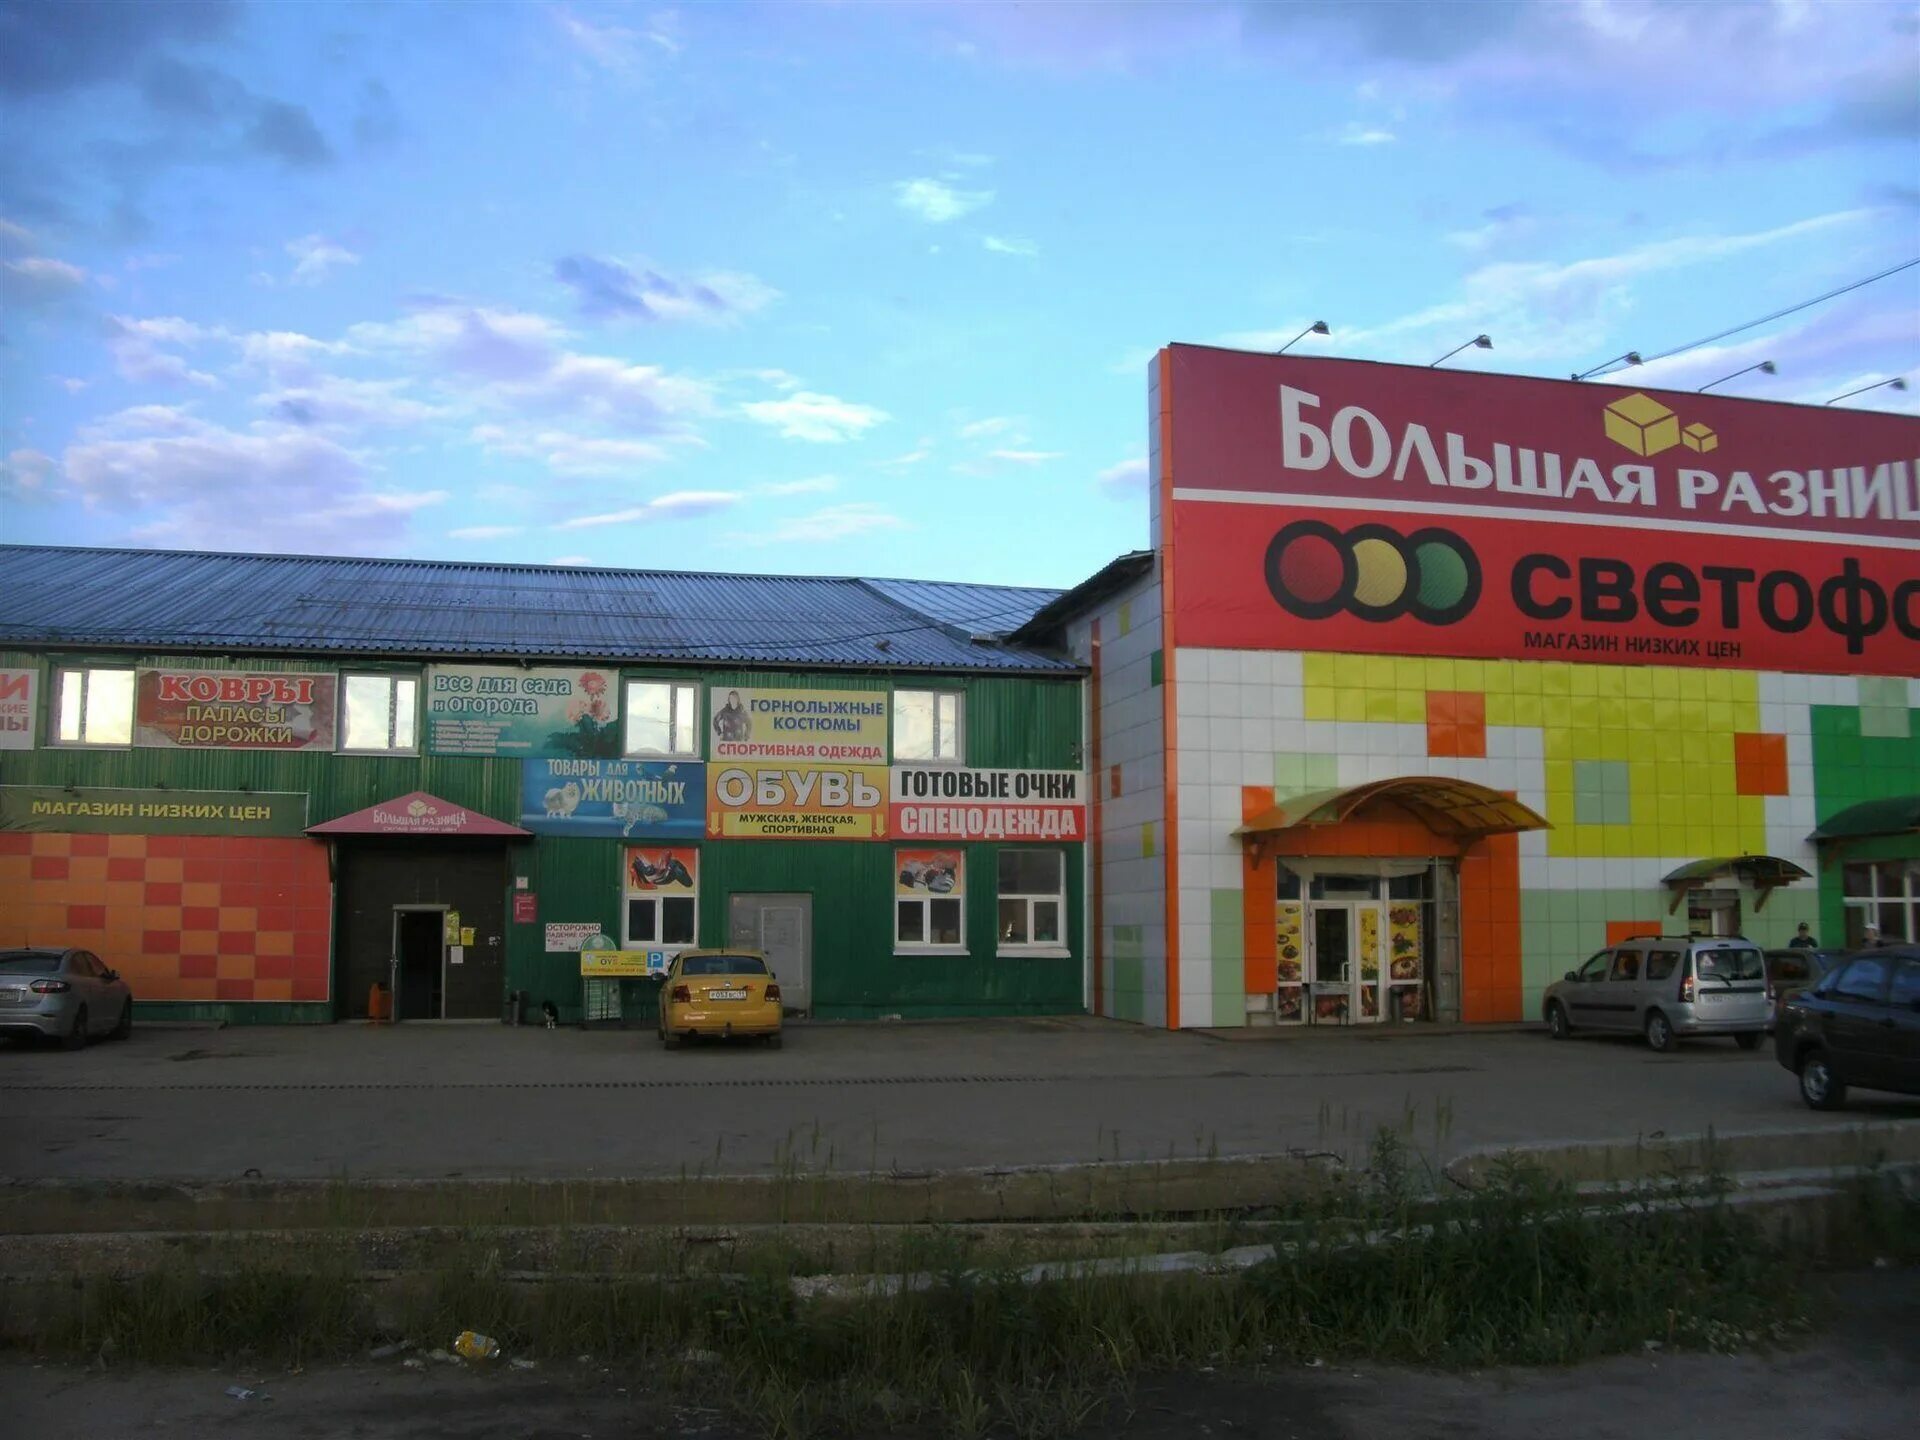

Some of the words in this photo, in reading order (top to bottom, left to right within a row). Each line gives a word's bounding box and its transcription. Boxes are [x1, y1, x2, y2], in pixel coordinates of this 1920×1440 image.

[1280, 384, 1657, 506] БОЛЬШАЯ
[1524, 631, 1618, 652] МАГАЗИН
[1626, 636, 1700, 657] НИЗКИХ
[1707, 641, 1741, 660] ЦЕН
[159, 675, 314, 704] КОВРЫ
[477, 676, 516, 694] для
[522, 679, 572, 695] сада
[186, 705, 286, 723] ПАЛАСЫ
[434, 700, 445, 712] и
[448, 697, 538, 717] огорода
[751, 699, 884, 715] ГОРНОЛЫЖНЫЕ
[773, 717, 861, 732] КОСТЮМЫ
[178, 725, 293, 744] ДОРОЖКИ
[717, 743, 815, 757] СПОРТИВНАЯ
[818, 745, 882, 759] ОДЕЖДА
[547, 759, 600, 777] ТОВАРЫ
[581, 778, 685, 804] ЖИВОТНЫХ
[716, 768, 881, 808] ОБУВЬ
[901, 771, 1009, 798] ГОТОВЫЕ
[1015, 773, 1076, 799] ОЧКИ
[32, 801, 133, 816] МАГАЗИН
[139, 804, 224, 818] НИЗКИХ
[229, 806, 271, 821] ЦЕН
[373, 809, 420, 826] БОЛЬШАЯ
[422, 810, 467, 829] РАЗНИЦА
[739, 814, 799, 824] МУЖСКАЯ,
[802, 815, 857, 825] ЖЕНСКАЯ,
[762, 825, 835, 834] СПОРТИВНАЯ
[900, 807, 1077, 838] СПЕЦОДЕЖДА
[546, 924, 600, 932] ОСТОРОЖНО
